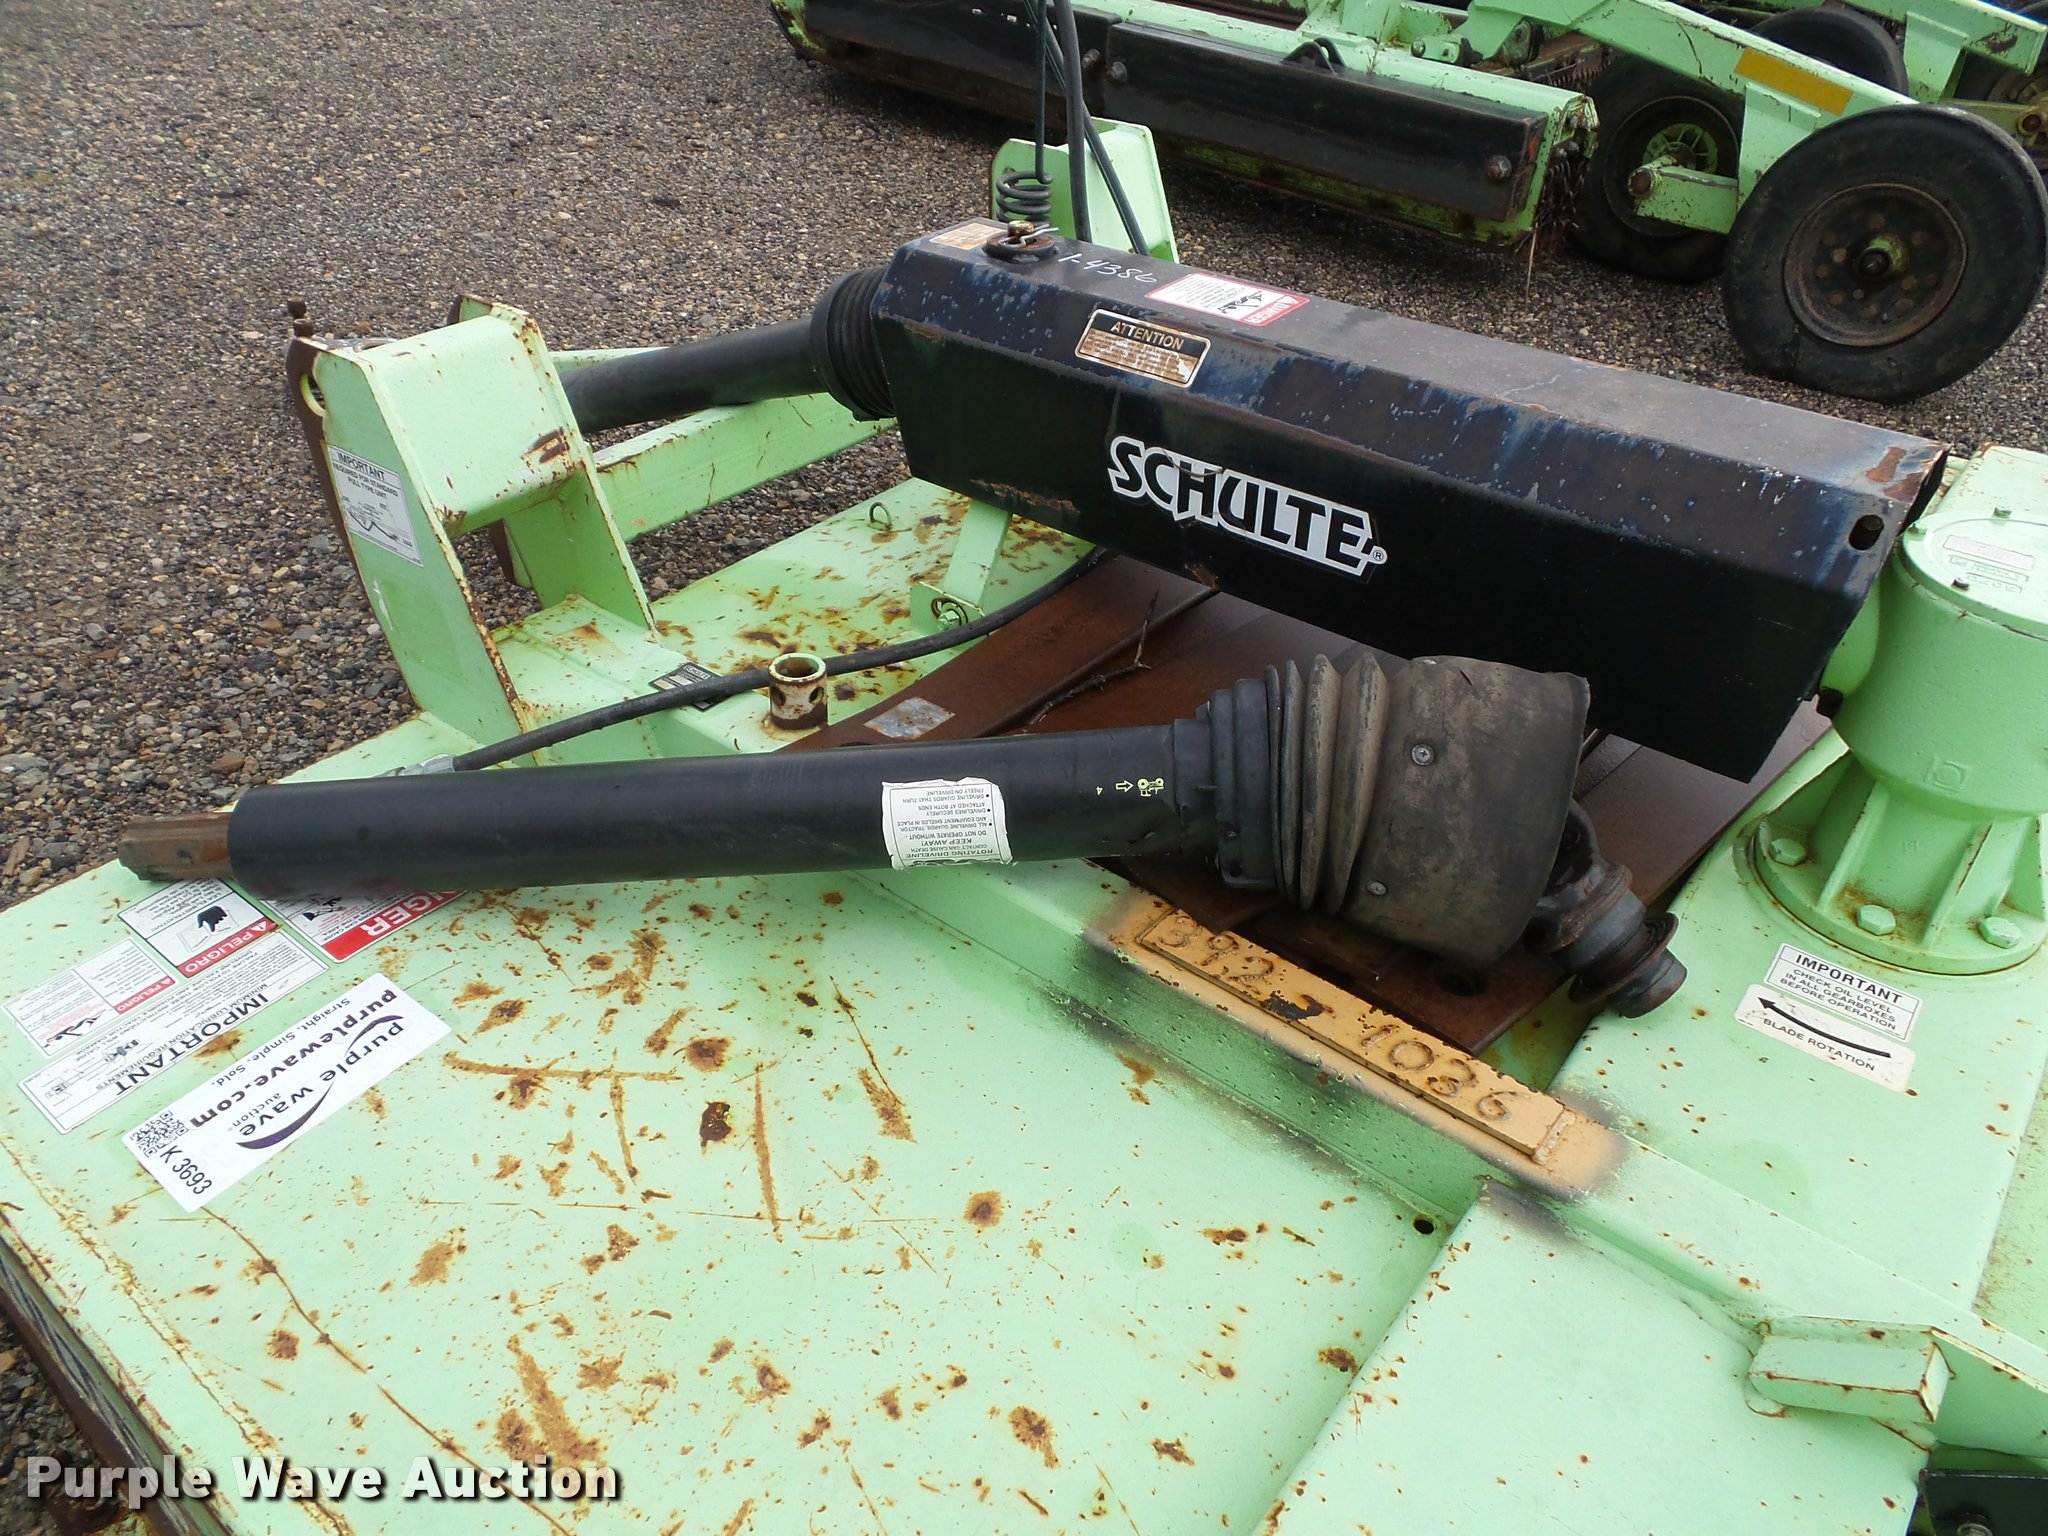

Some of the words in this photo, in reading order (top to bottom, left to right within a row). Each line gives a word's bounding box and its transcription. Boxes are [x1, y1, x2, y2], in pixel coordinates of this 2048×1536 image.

[1058, 251, 1158, 283] 1-4386
[1111, 321, 1184, 350] ATTENTION
[338, 452, 385, 480] IMPORTANT
[1110, 440, 1374, 568] SCHULTE
[184, 931, 254, 973] PELIGRO
[115, 982, 163, 1012] PELIGRO
[227, 982, 268, 1008] MINIMUM
[1785, 972, 1797, 981] IN
[1799, 978, 1821, 991] ALL
[1823, 988, 1896, 1022] GEARBOXES
[1793, 969, 1833, 988] CHECK
[1834, 985, 1853, 997] OIL
[1857, 994, 1893, 1013] LEVEL
[1795, 954, 1903, 1004] IMPORTANT
[167, 1006, 229, 1045] LUBRICATION
[295, 996, 351, 1034] Straight.
[1780, 977, 1825, 1000] BEFORE
[1827, 998, 1897, 1030] OPERATION
[116, 992, 270, 1096] IMPORTANT
[187, 988, 400, 1132] purplewave.com
[244, 1030, 297, 1066] Simple.
[316, 1021, 406, 1085] purple
[1763, 1018, 1805, 1041] BLADE
[1807, 1039, 1875, 1071] ROTATION
[93, 1043, 168, 1091] REQUIREMENTS
[210, 1063, 247, 1090] Sold.
[230, 1091, 283, 1129] auction
[236, 1083, 315, 1139] wave
[160, 1144, 180, 1163] K
[171, 1157, 212, 1195] 3693
